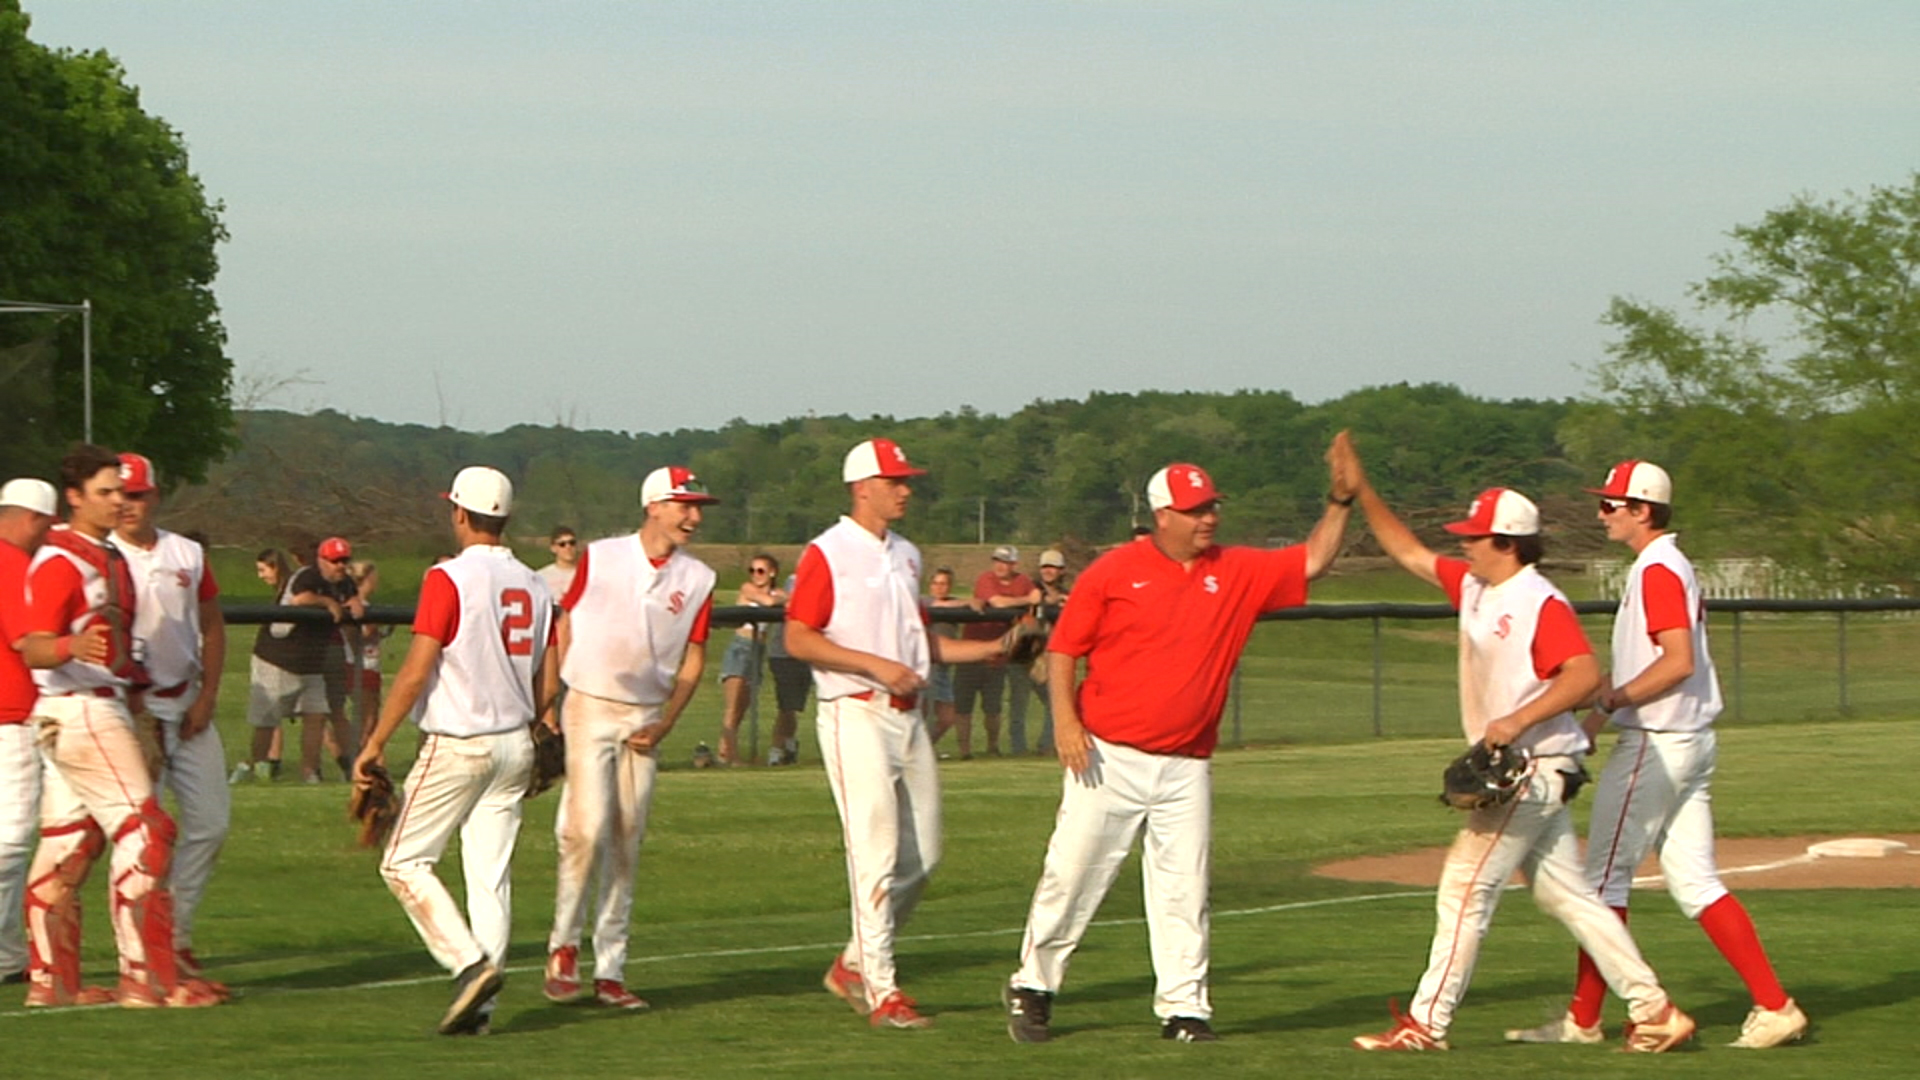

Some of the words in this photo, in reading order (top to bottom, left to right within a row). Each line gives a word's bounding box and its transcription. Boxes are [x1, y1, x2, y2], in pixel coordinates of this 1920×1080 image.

[1188, 470, 1203, 489] S
[1204, 576, 1219, 595] S
[667, 591, 684, 615] S
[500, 588, 533, 656] 2
[1494, 613, 1513, 640] S
